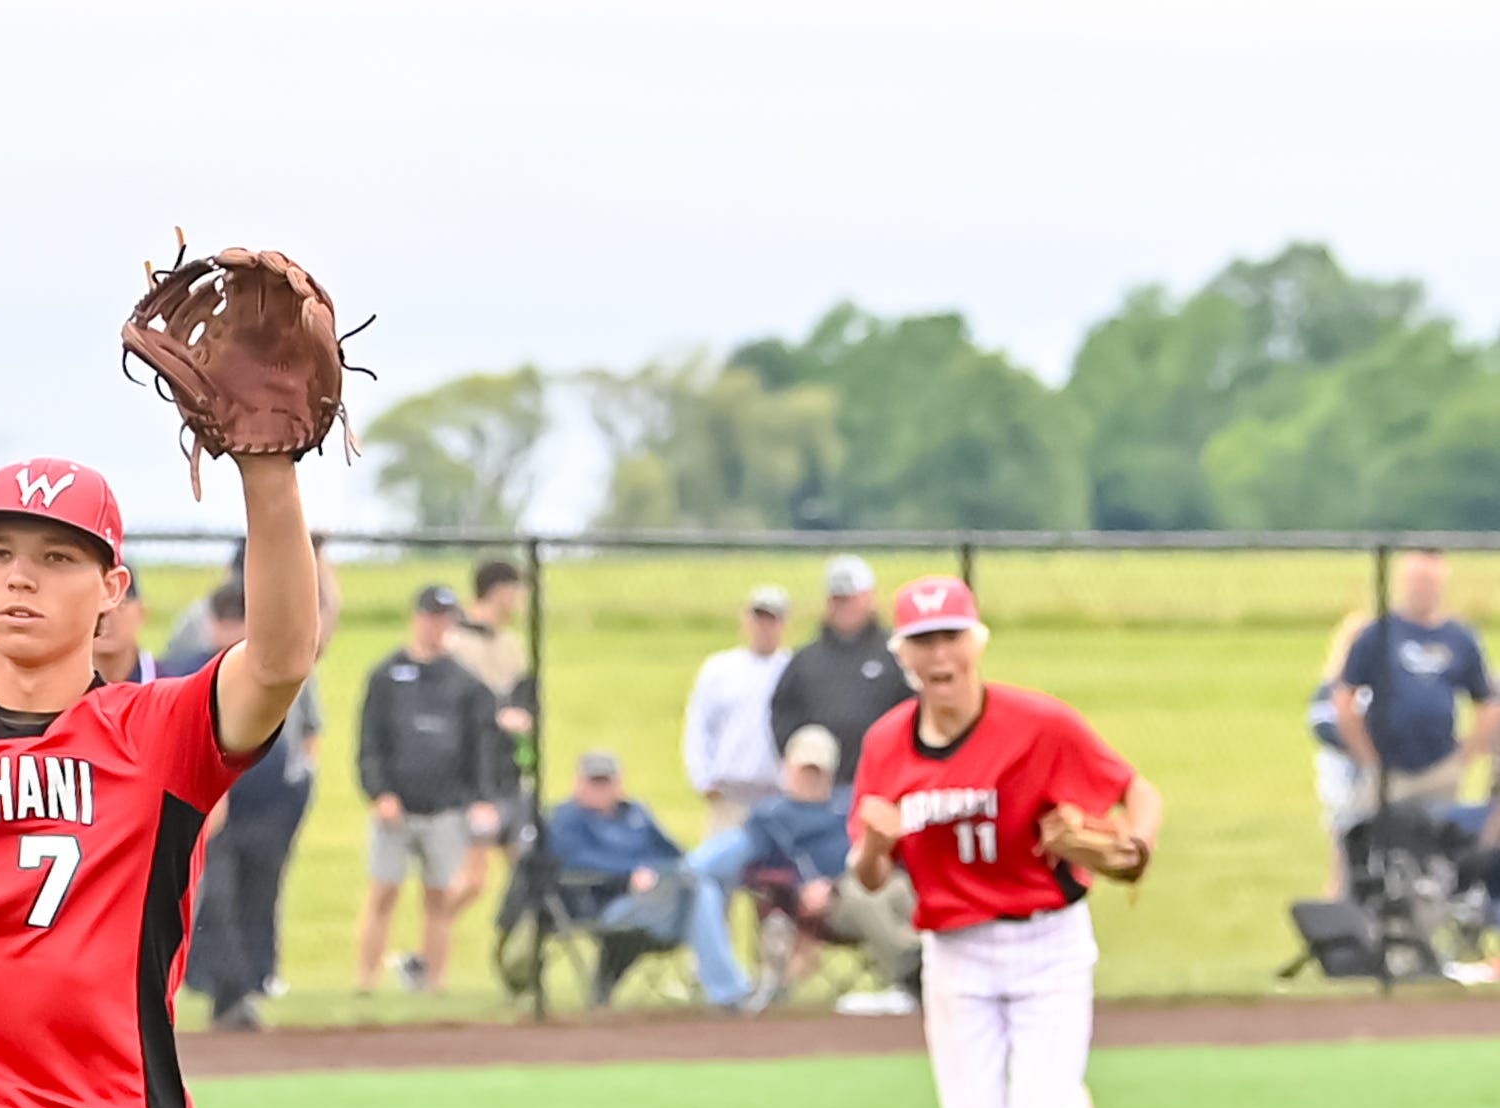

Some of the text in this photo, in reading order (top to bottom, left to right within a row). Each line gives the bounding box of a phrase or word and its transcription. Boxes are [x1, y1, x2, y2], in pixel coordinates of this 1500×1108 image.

[15, 467, 76, 510] W
[911, 587, 948, 615] W
[953, 820, 998, 865] 11
[18, 833, 82, 928] 7
